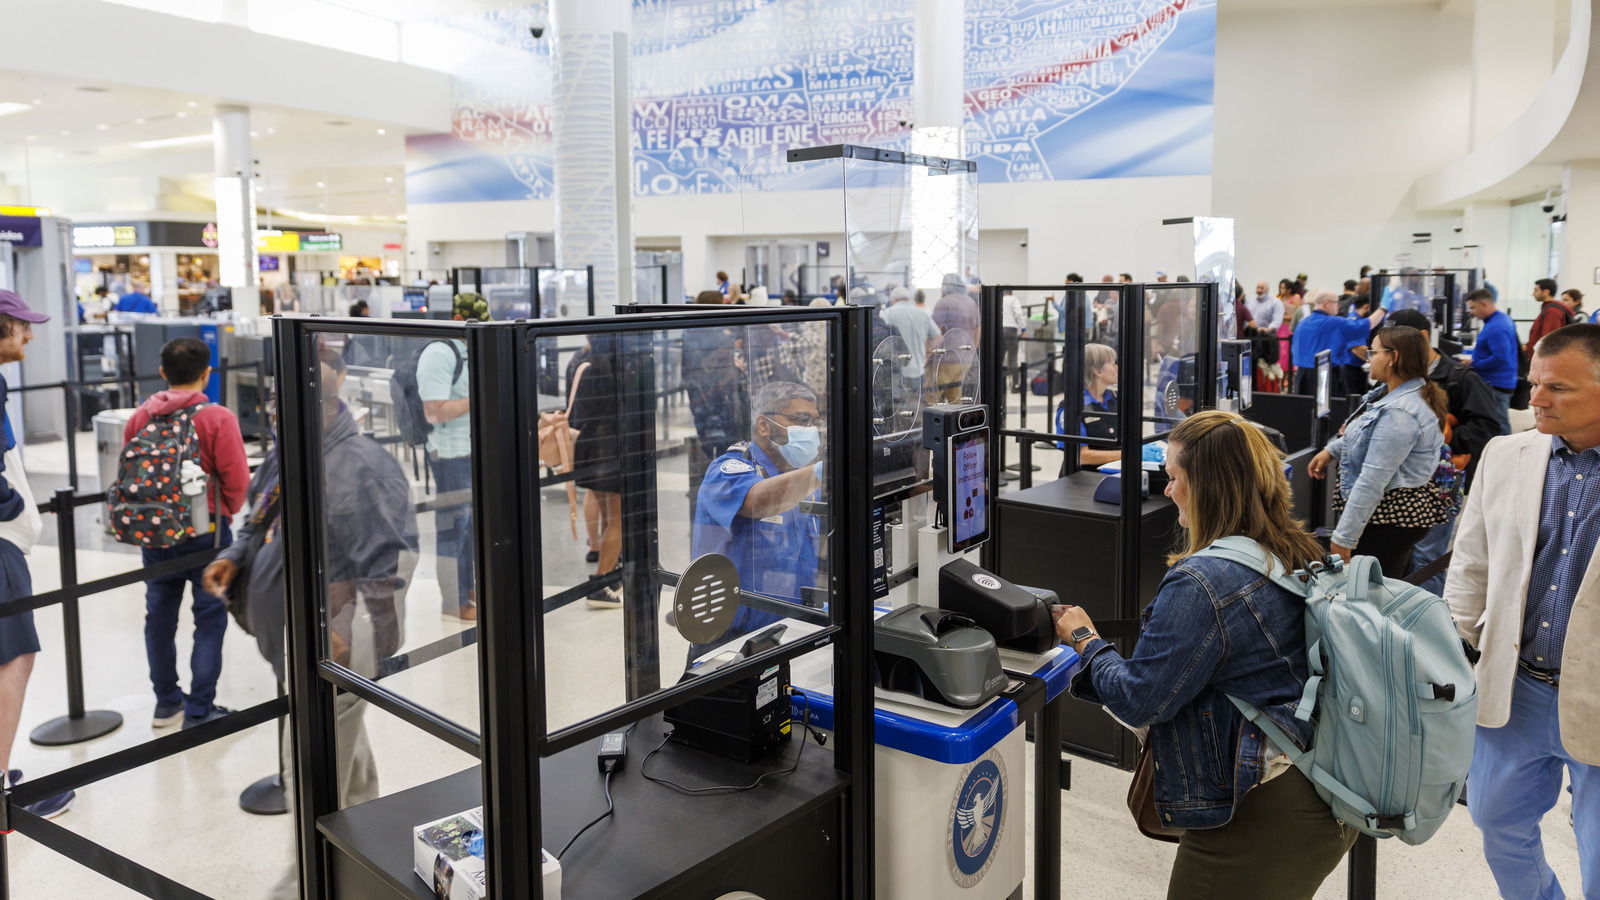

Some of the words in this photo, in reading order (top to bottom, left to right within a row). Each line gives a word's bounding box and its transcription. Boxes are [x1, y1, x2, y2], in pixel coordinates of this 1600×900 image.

[785, 22, 851, 36] IOWA
[1010, 21, 1035, 33] BUS
[1043, 14, 1136, 35] HARRISBURG
[671, 39, 777, 57] LINCOLN
[803, 50, 849, 68] JEFF
[1032, 64, 1089, 74] CAROLINA
[809, 76, 887, 89] MISSOURI
[1006, 74, 1060, 84] NORTH
[811, 91, 876, 102] ARKAN
[978, 90, 1012, 101] GEO
[677, 105, 716, 117] ANNA
[984, 98, 1034, 111] RGIA
[993, 107, 1048, 123] ATLA
[677, 116, 718, 130] CISCO
[996, 121, 1039, 135] NTA
[724, 124, 814, 148] ABILENE
[822, 126, 868, 136] BATON
[647, 129, 668, 149] FE
[1012, 162, 1041, 173] LAH
[963, 452, 977, 460] Follow
[958, 471, 983, 484] Instructions
[990, 748, 1008, 801] SECURITY
[951, 824, 1005, 887] ADMINISTRATION
